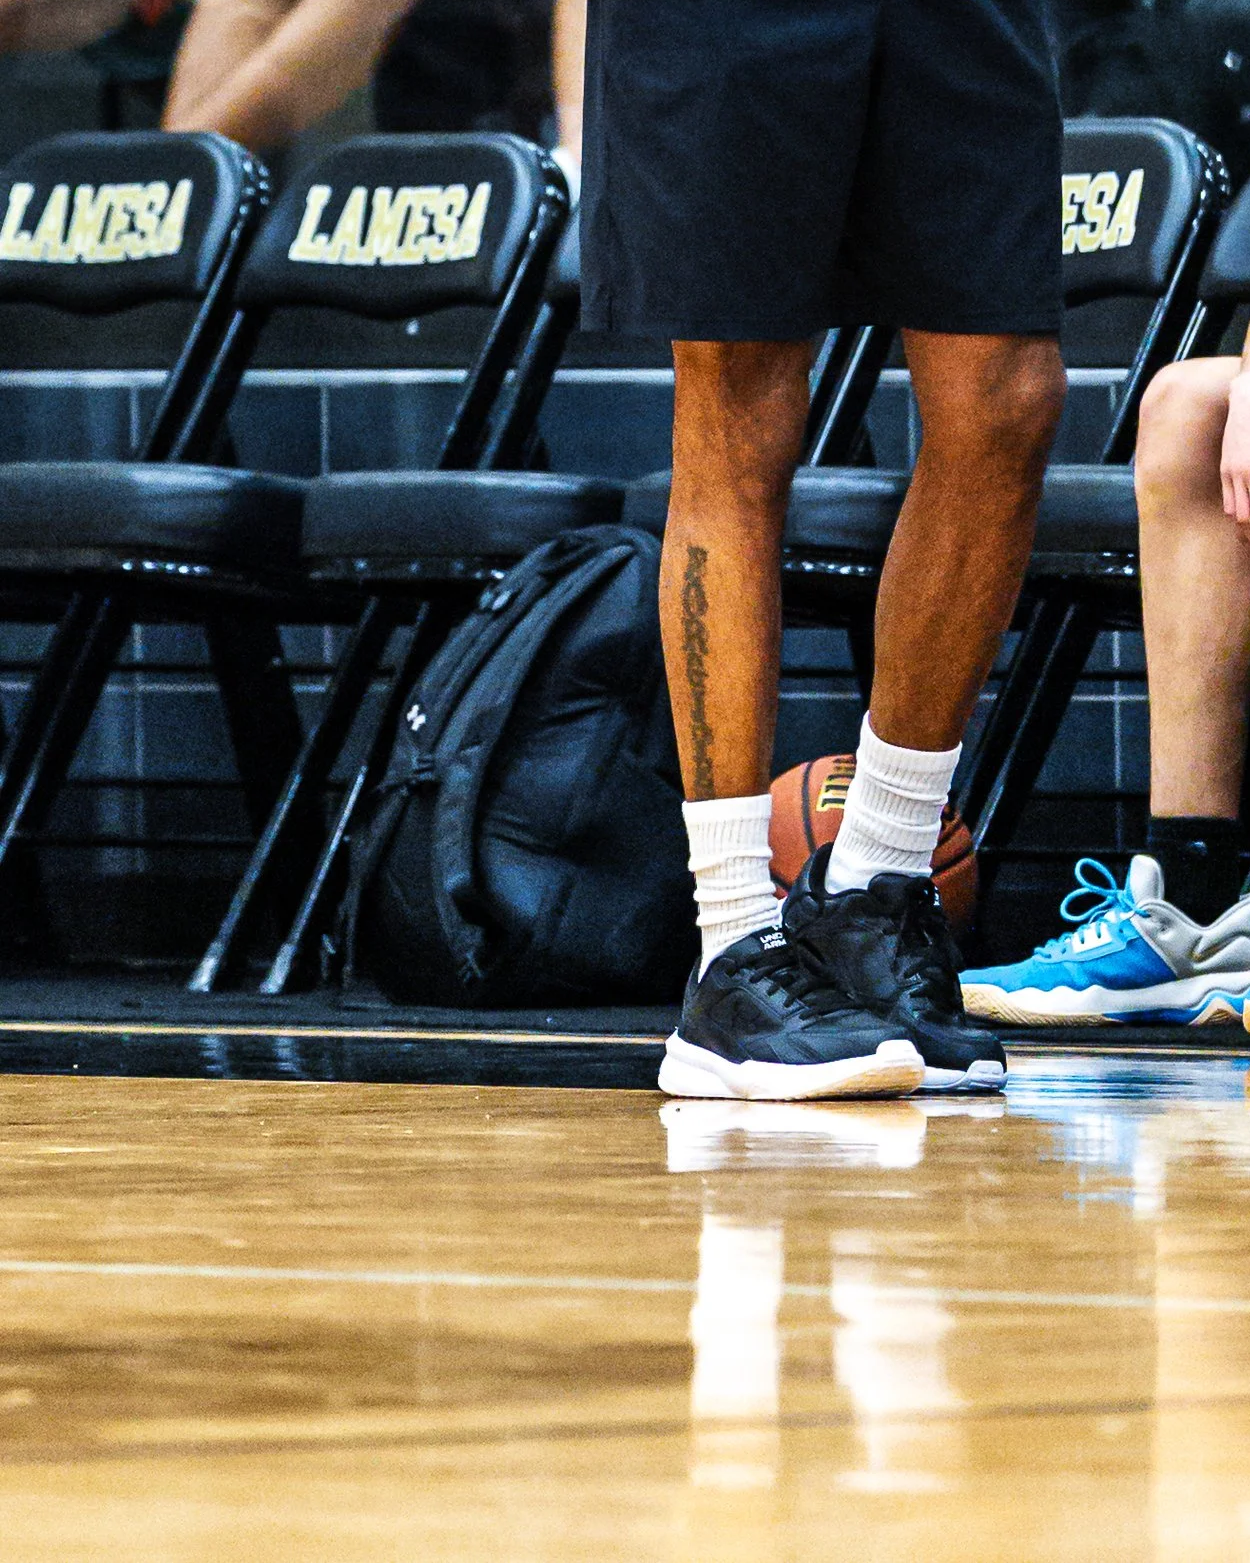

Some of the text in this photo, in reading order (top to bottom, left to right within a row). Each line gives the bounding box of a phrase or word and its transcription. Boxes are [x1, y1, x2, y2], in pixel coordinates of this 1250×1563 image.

[0, 178, 193, 264] LAMESA
[288, 181, 492, 267] LAMESA
[1061, 168, 1145, 255] ESA
